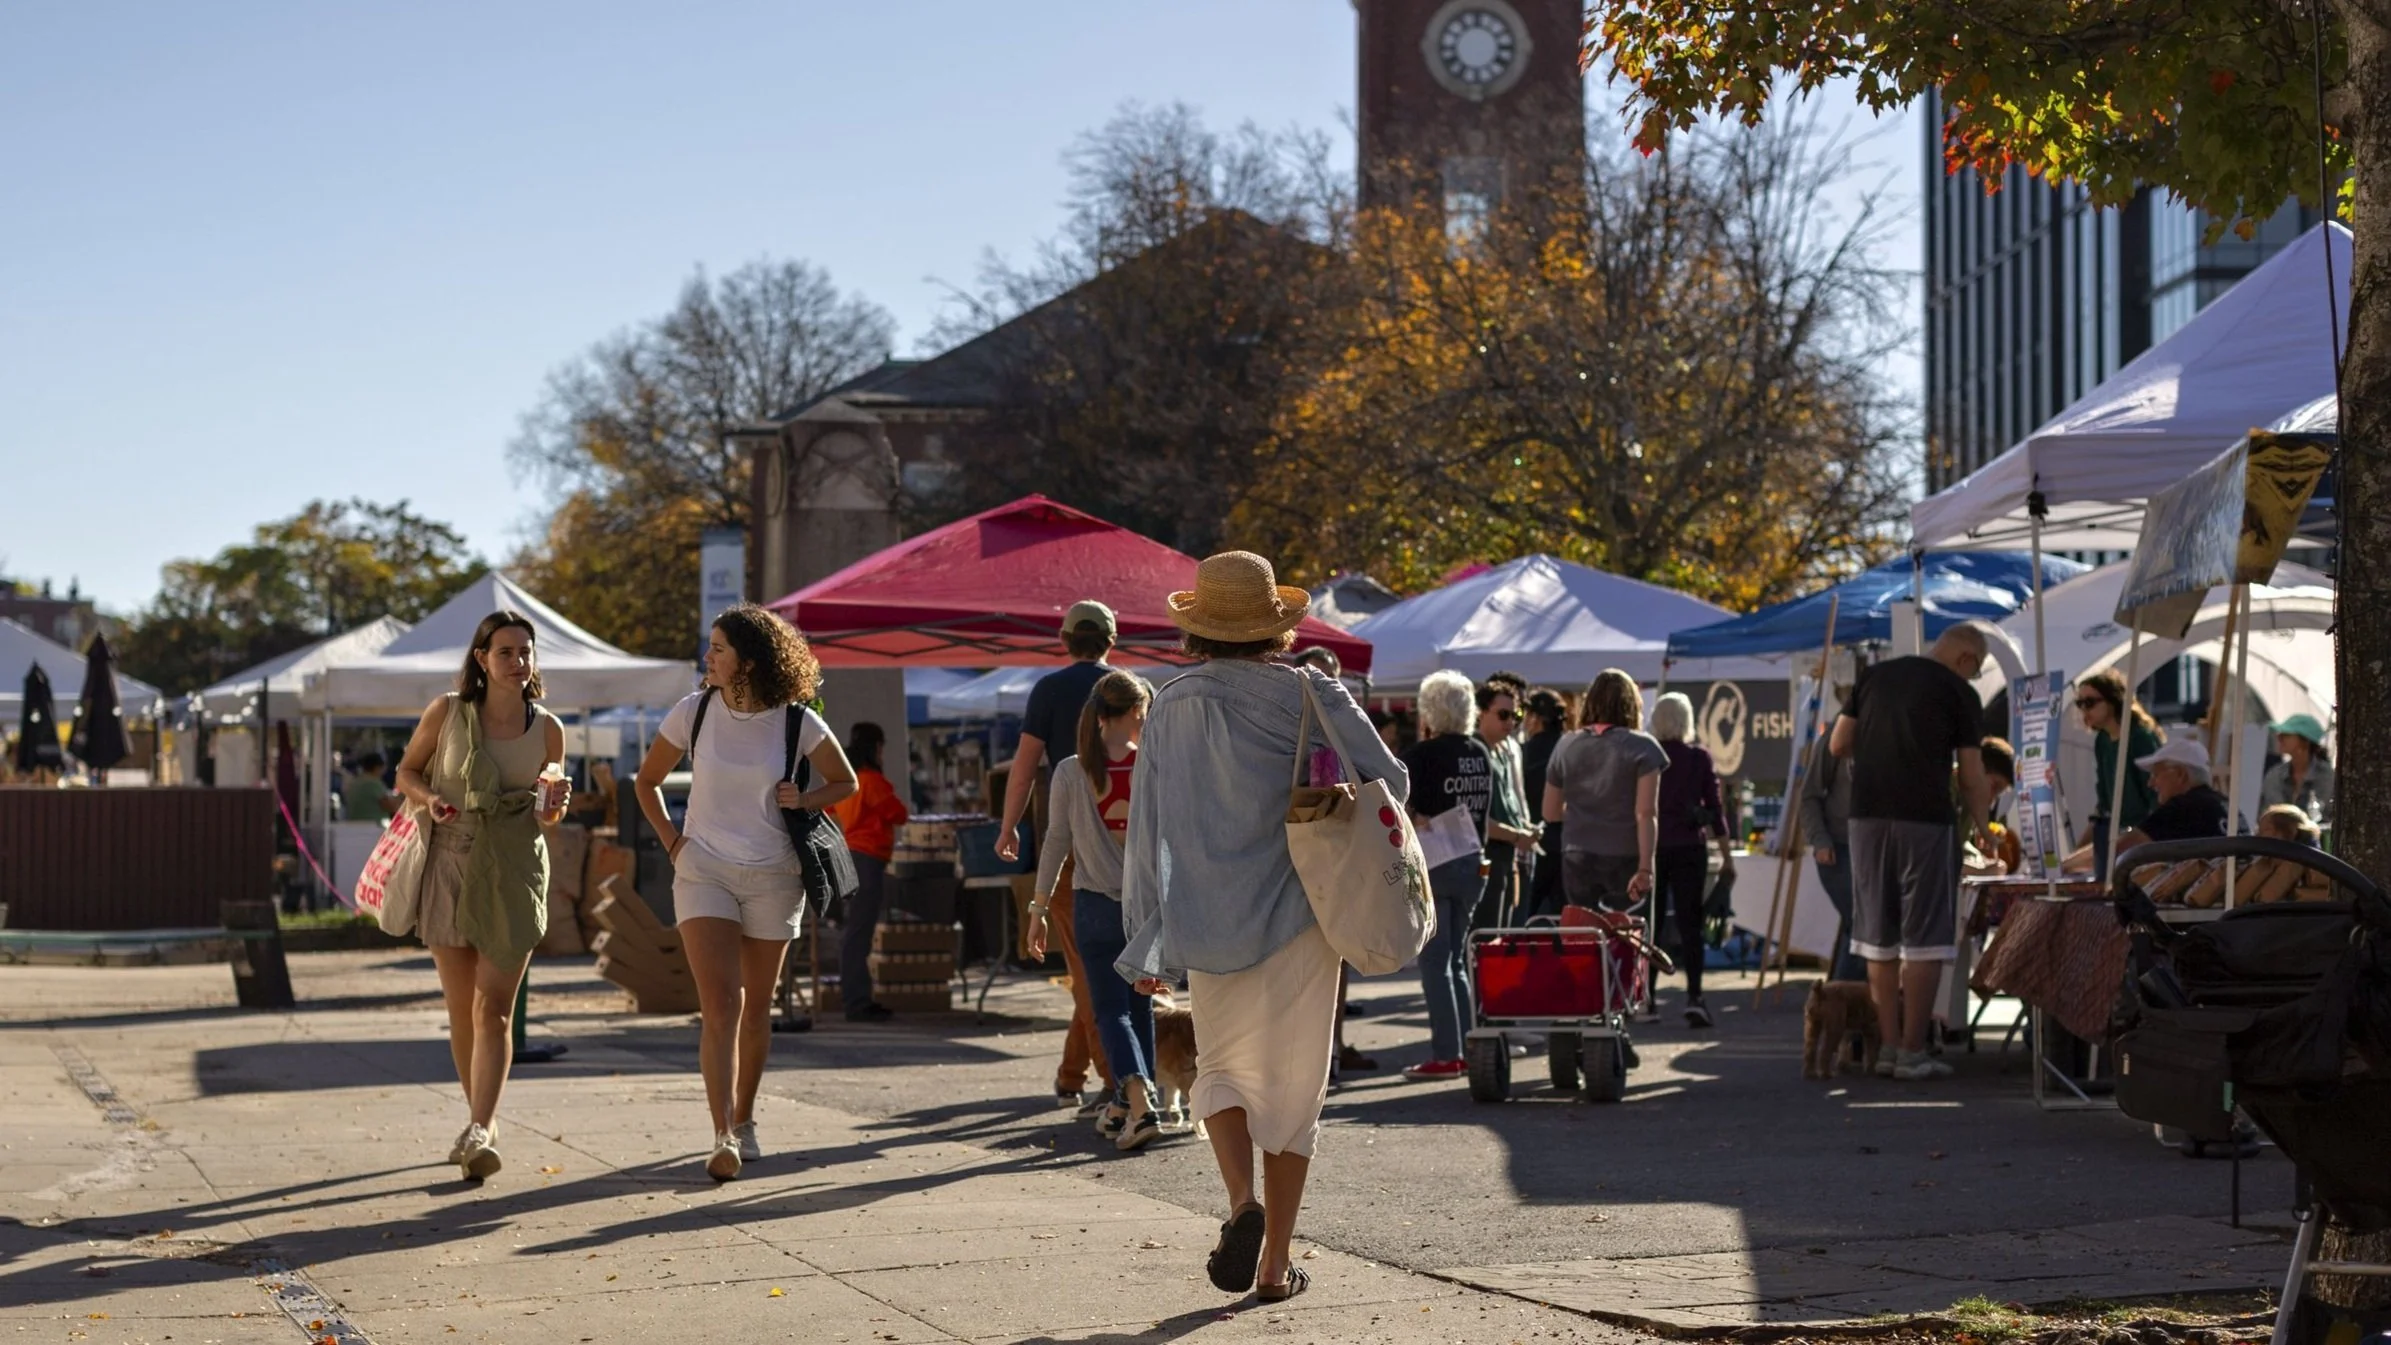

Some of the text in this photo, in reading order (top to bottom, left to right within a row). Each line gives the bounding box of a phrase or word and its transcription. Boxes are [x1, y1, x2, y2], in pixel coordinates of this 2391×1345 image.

[1752, 711, 1794, 739] FISH
[1458, 757, 1485, 773] RENT
[1444, 776, 1491, 794] CONTRO
